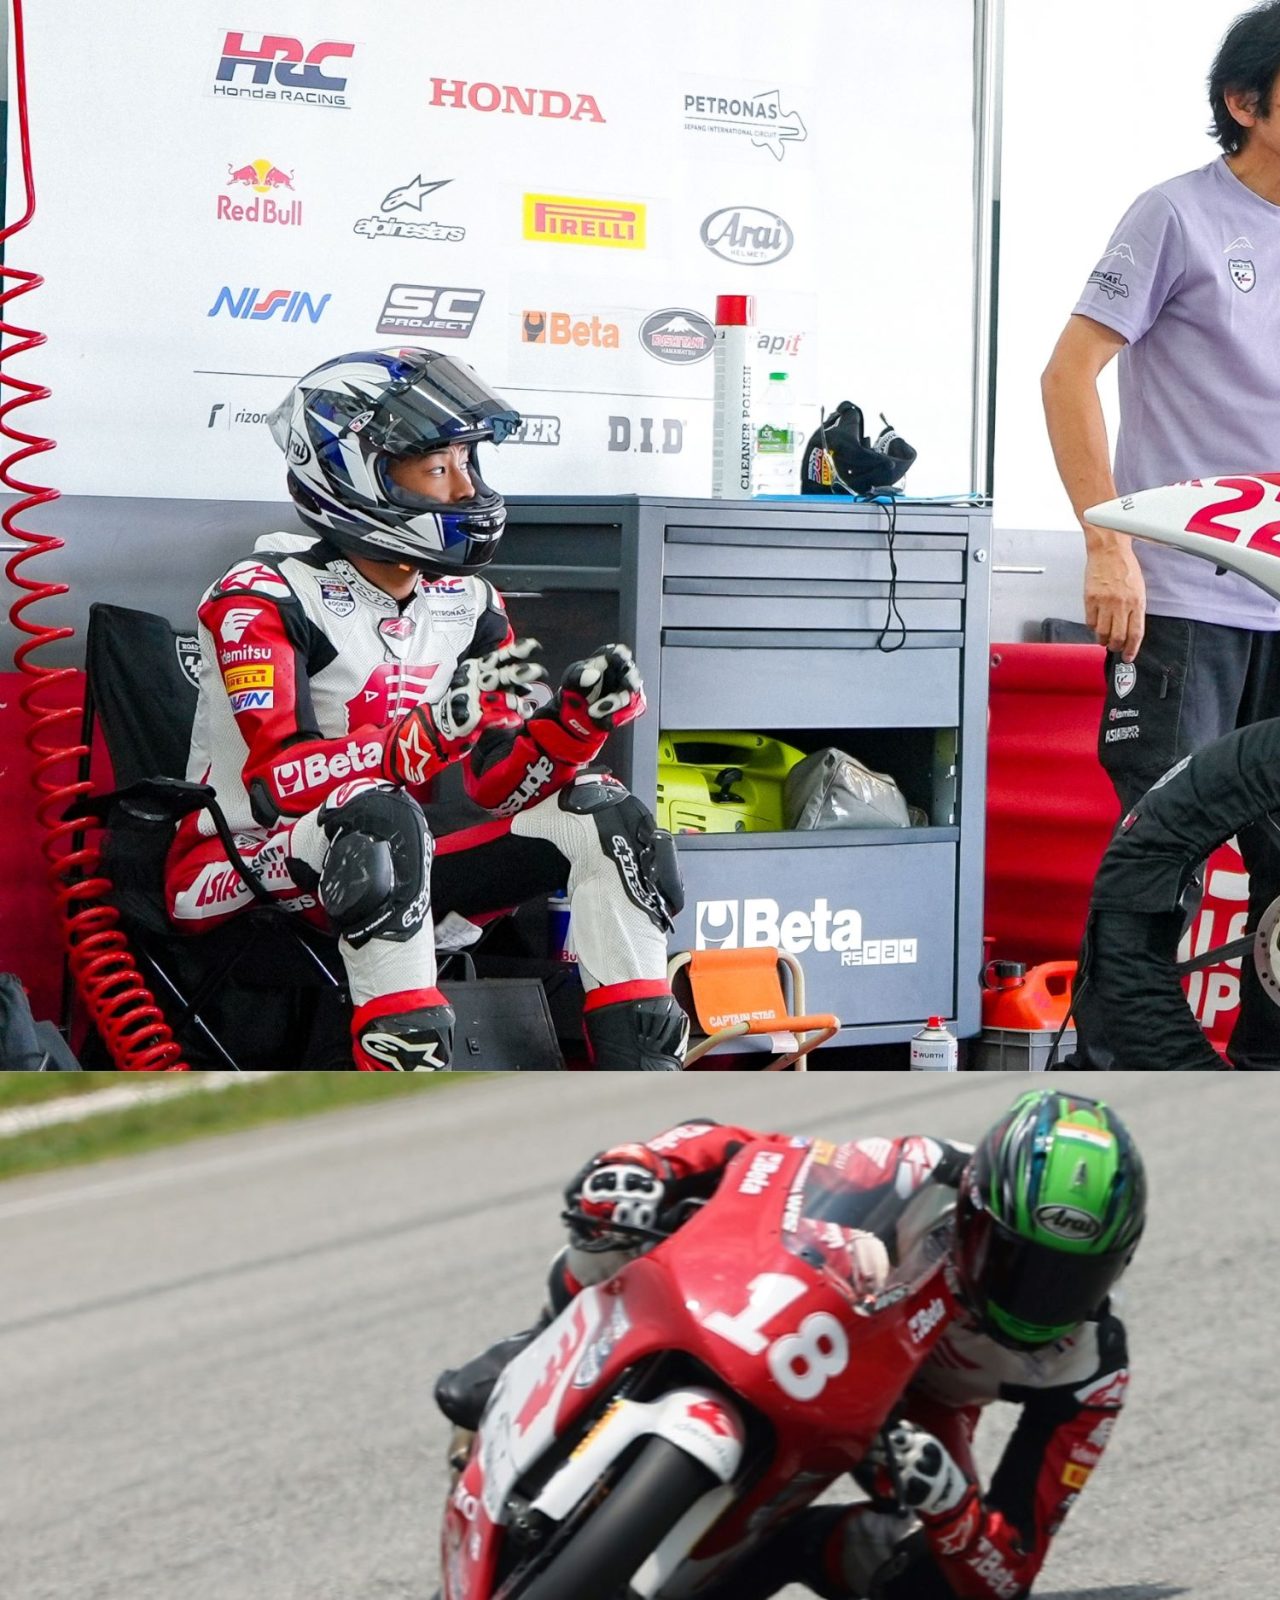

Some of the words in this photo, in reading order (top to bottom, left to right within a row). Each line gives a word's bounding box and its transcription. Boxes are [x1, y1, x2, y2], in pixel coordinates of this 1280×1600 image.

[216, 32, 354, 91] HRC
[214, 85, 277, 100] Honda
[281, 90, 346, 106] RACING
[429, 78, 606, 124] HONDA
[684, 95, 778, 120] PETRONAS
[217, 195, 259, 222] Red
[264, 199, 302, 226] Bull
[353, 215, 466, 243] alpinestars
[535, 203, 636, 240] PIRELLI
[705, 212, 784, 249] Arai
[385, 287, 482, 321] SC
[381, 317, 471, 331] PROJECT
[550, 312, 620, 348] Beta
[757, 330, 801, 354] apit
[742, 366, 752, 418] POLISH
[608, 416, 684, 455] D.I.D
[740, 423, 751, 490] CLEANER
[304, 740, 382, 789] Beta
[744, 898, 862, 953] Beta
[1041, 1210, 1092, 1233] Arai
[703, 1272, 848, 1401] 18
